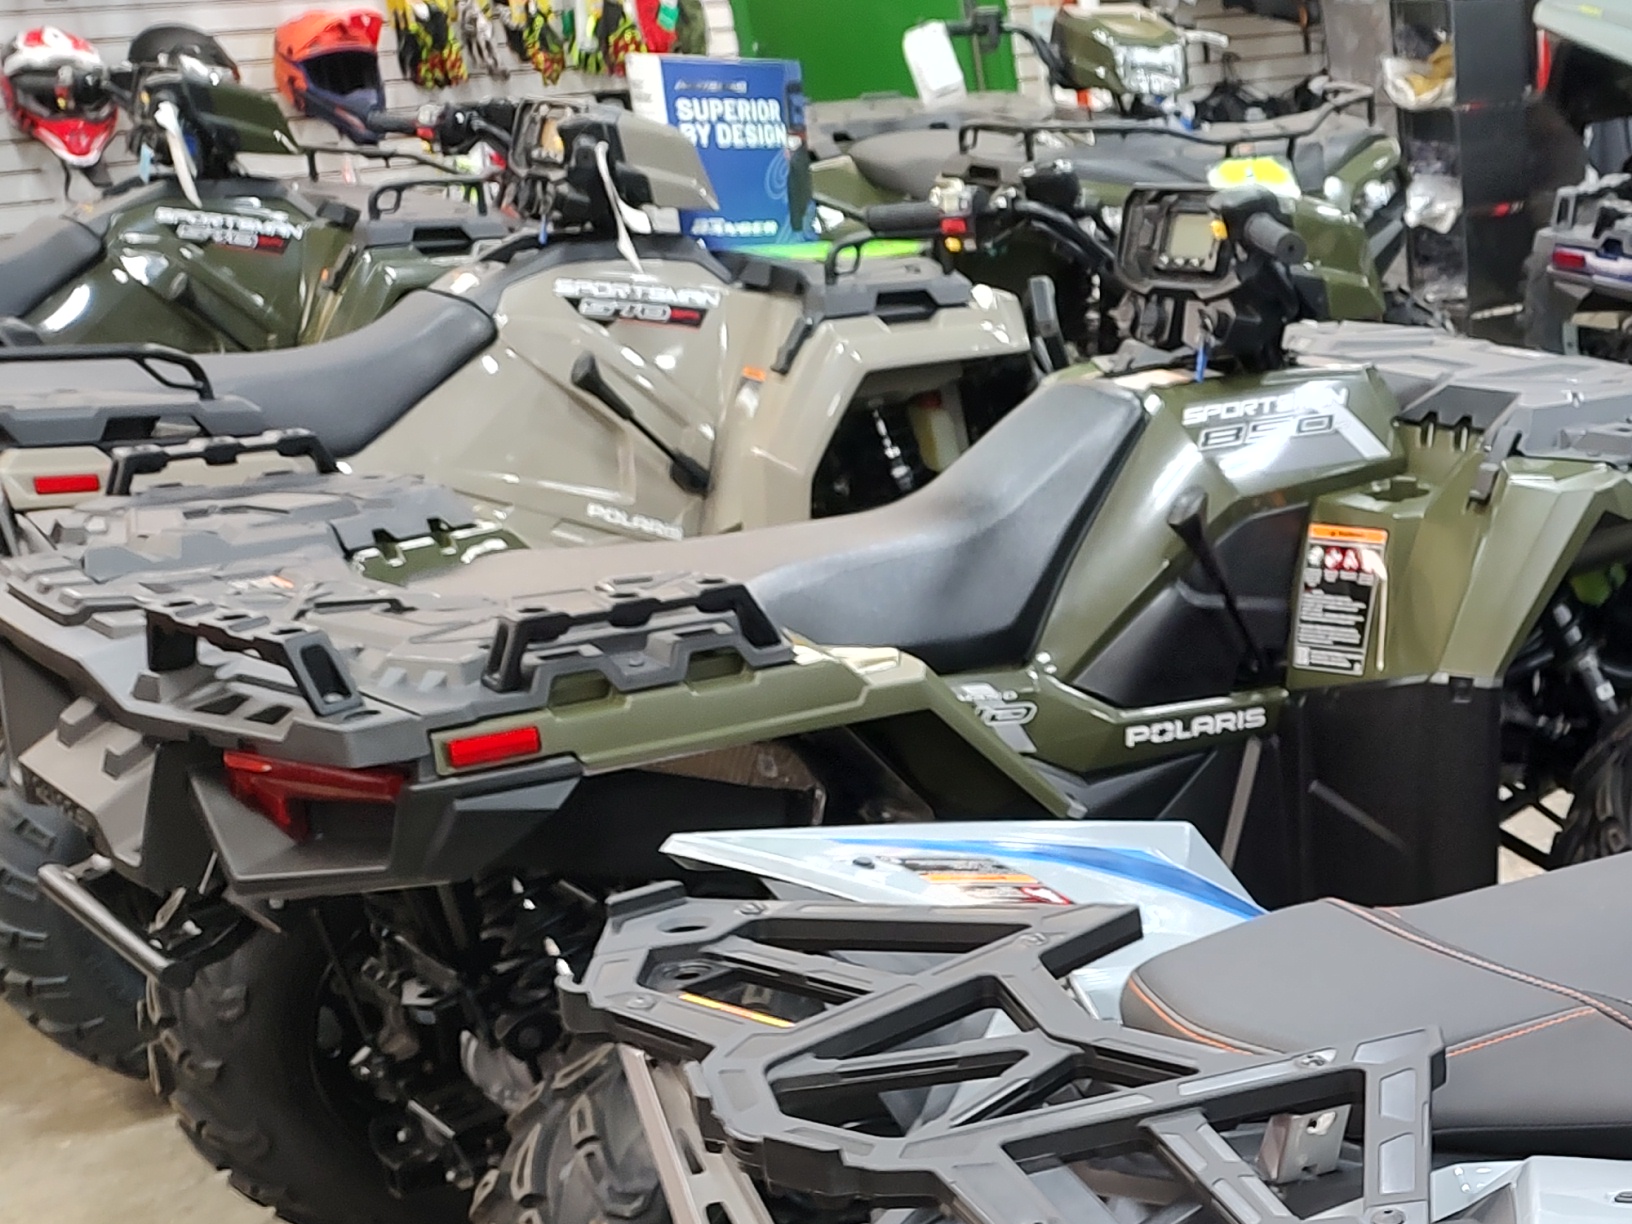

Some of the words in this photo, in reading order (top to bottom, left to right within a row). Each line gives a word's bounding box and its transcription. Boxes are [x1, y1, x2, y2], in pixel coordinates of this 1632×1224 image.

[675, 97, 782, 123] SUPERIOR
[679, 122, 711, 148] BY
[714, 122, 787, 149] DESIGN
[154, 206, 304, 240] SPORTSMAN
[553, 278, 722, 308] SPORTSMAN
[1182, 380, 1349, 426] SPORTSN
[1198, 412, 1337, 450] 850
[1124, 706, 1268, 749] POLARIS
